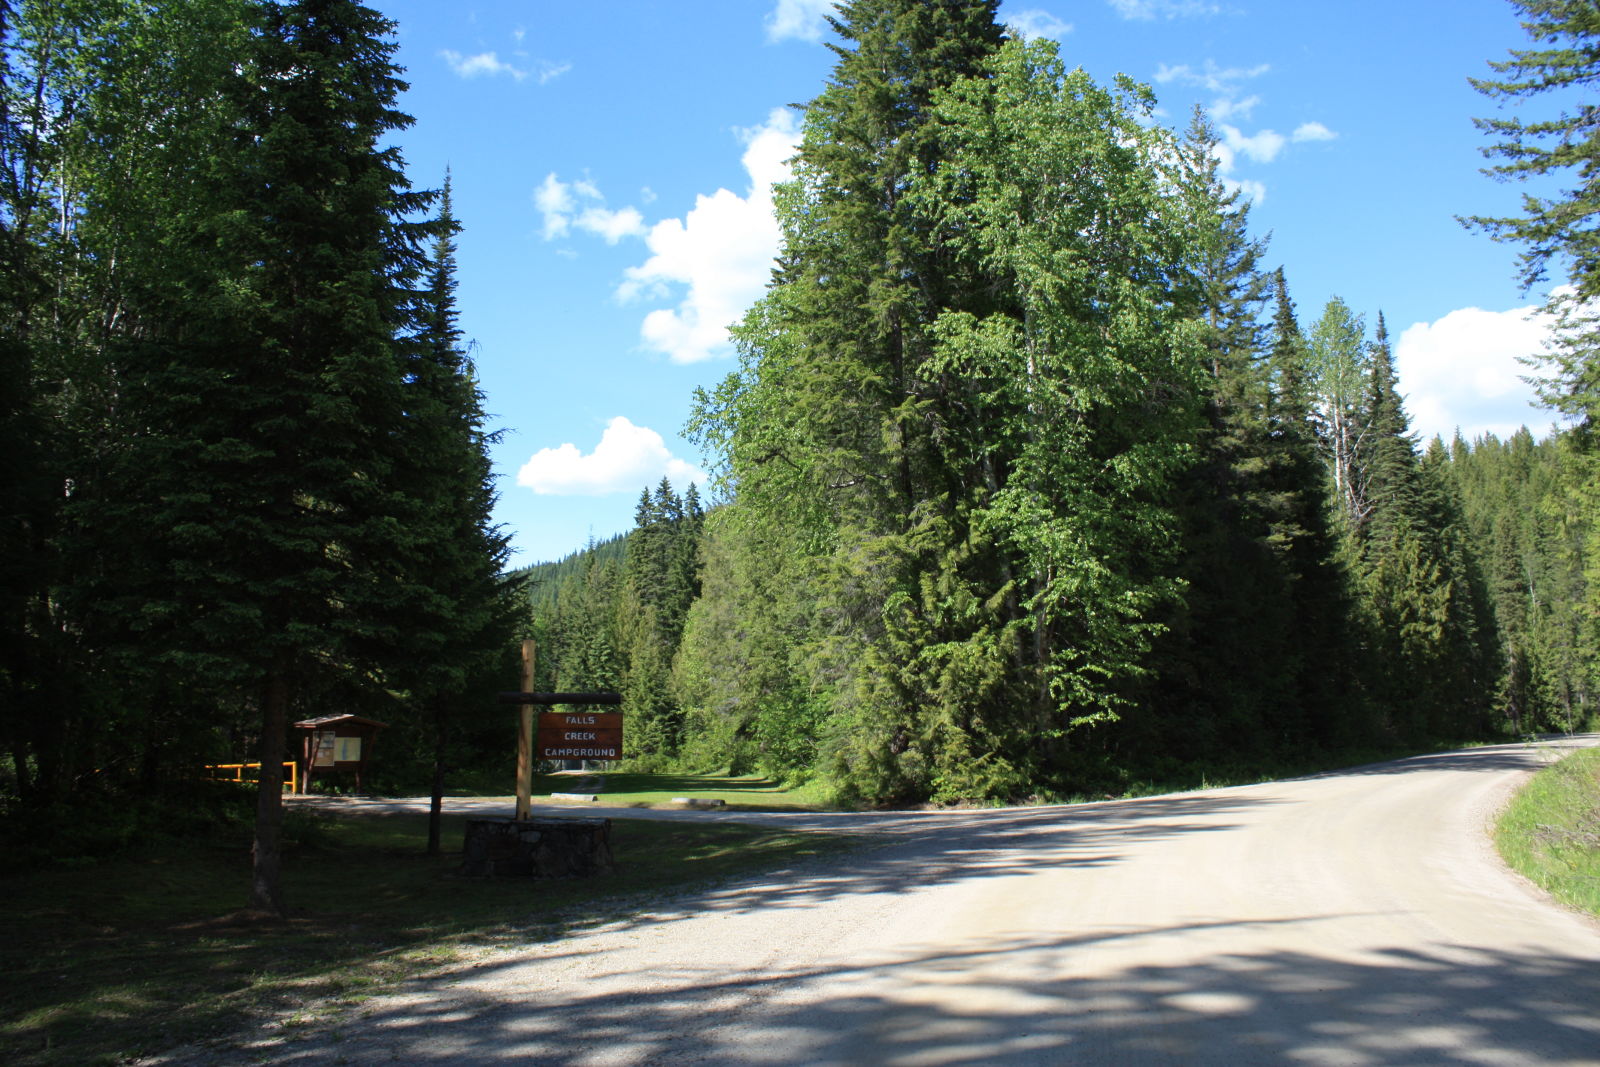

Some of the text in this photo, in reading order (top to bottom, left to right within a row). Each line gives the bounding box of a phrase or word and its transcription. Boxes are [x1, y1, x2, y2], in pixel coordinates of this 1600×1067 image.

[565, 716, 595, 724] FALLS
[564, 732, 596, 740] CREEK
[544, 748, 616, 757] CAMPGROUND
